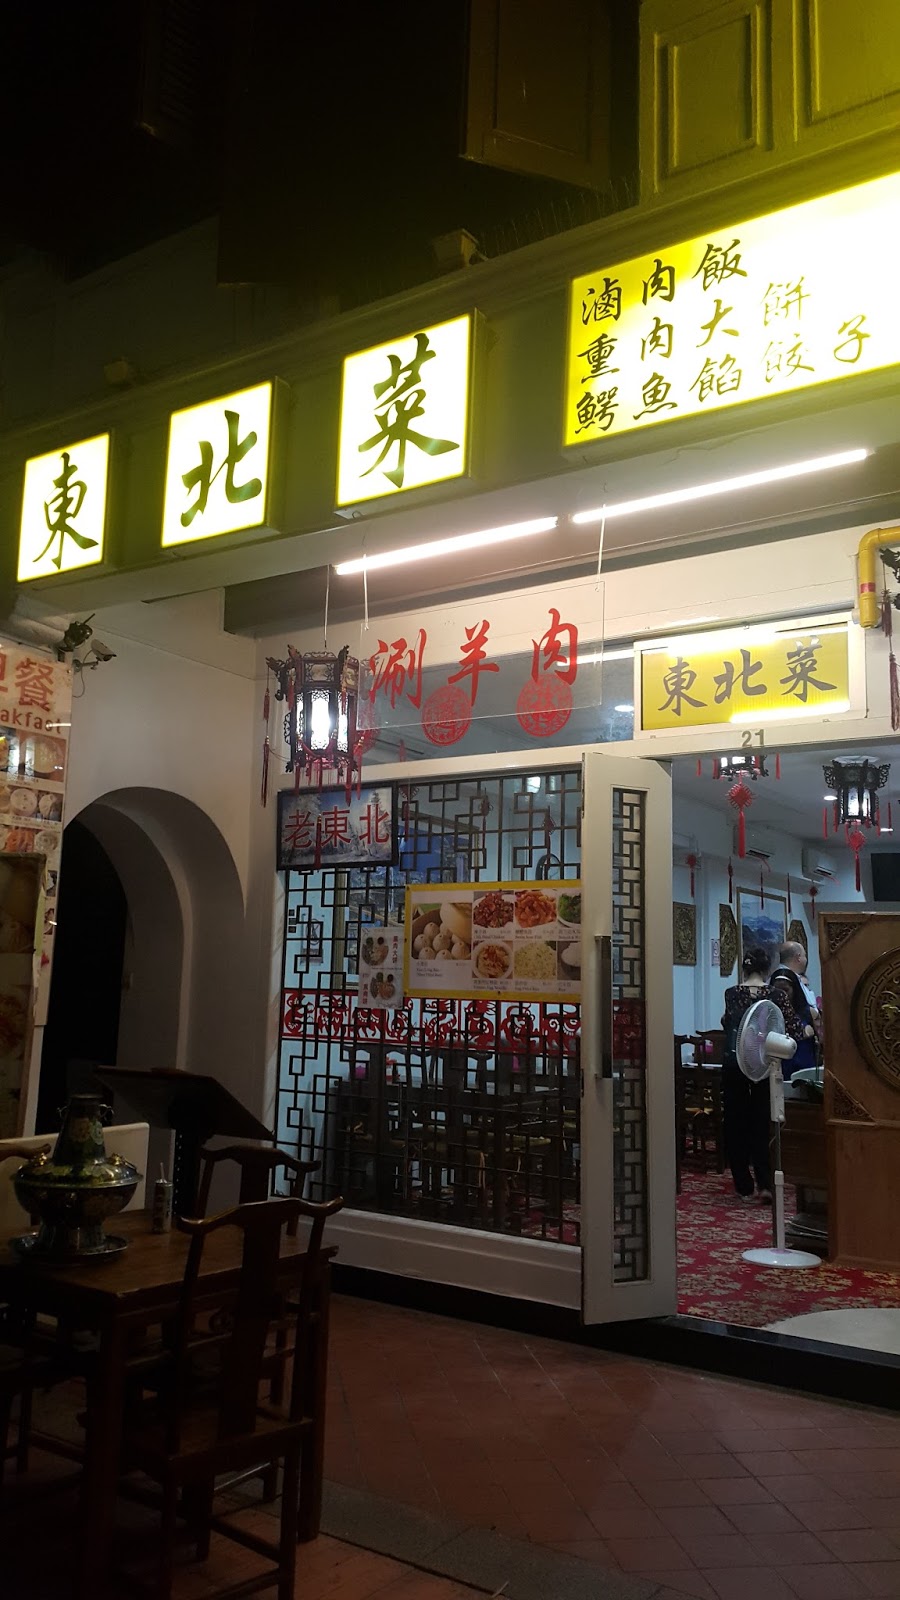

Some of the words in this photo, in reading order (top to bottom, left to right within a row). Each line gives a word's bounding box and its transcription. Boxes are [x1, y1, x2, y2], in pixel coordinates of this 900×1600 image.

[581, 239, 748, 326] 滷肉飯
[33, 333, 460, 570] 東北菜
[0, 652, 54, 712] 餐
[369, 608, 579, 710] 涮羊肉
[658, 635, 838, 717] 東北菜
[740, 729, 765, 748] 21
[284, 804, 390, 850] 老東北
